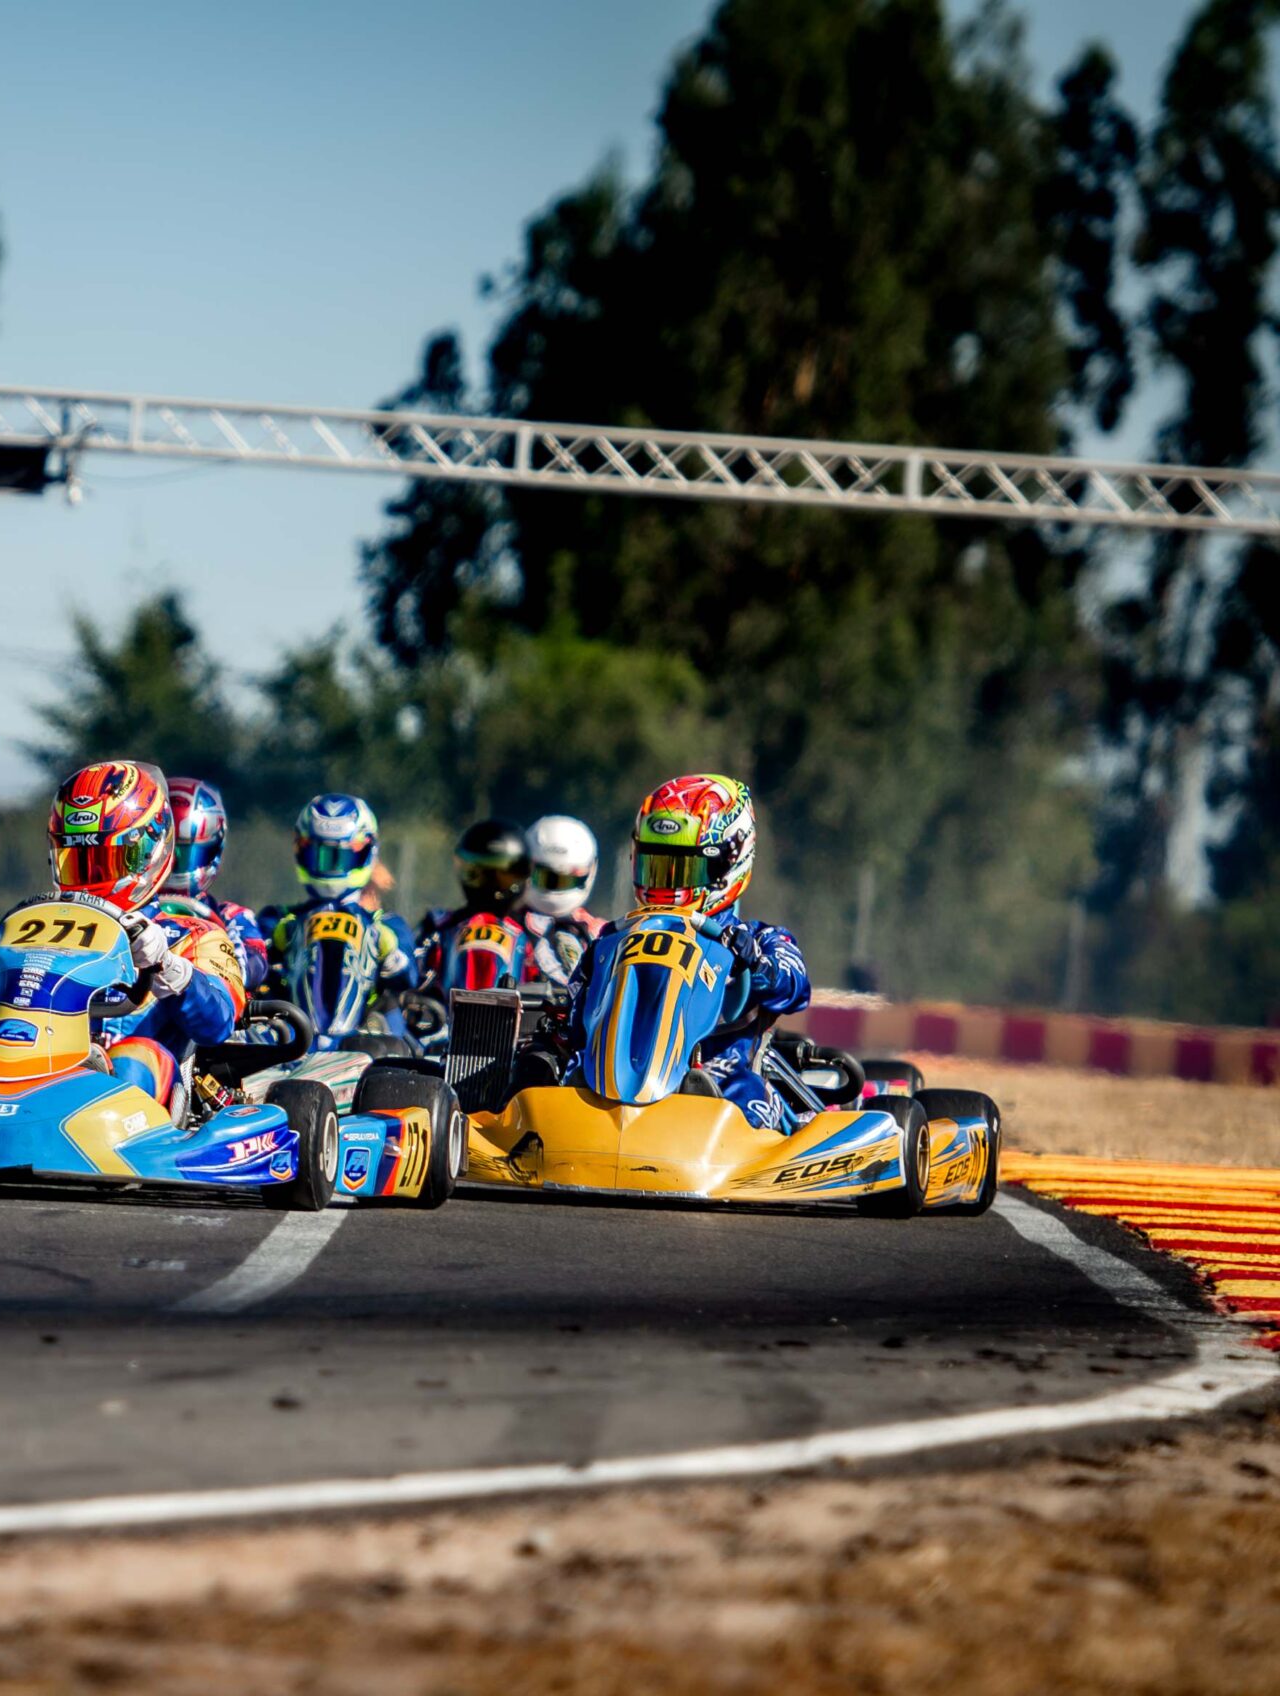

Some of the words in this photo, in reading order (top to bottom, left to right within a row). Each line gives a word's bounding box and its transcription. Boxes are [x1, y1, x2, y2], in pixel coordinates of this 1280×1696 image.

[69, 812, 96, 823] Arai
[655, 818, 679, 832] Arai
[11, 919, 99, 947] 271
[622, 932, 697, 971] 201
[400, 1122, 428, 1187] 271
[773, 1153, 856, 1184] EOS
[944, 1157, 970, 1185] EOS
